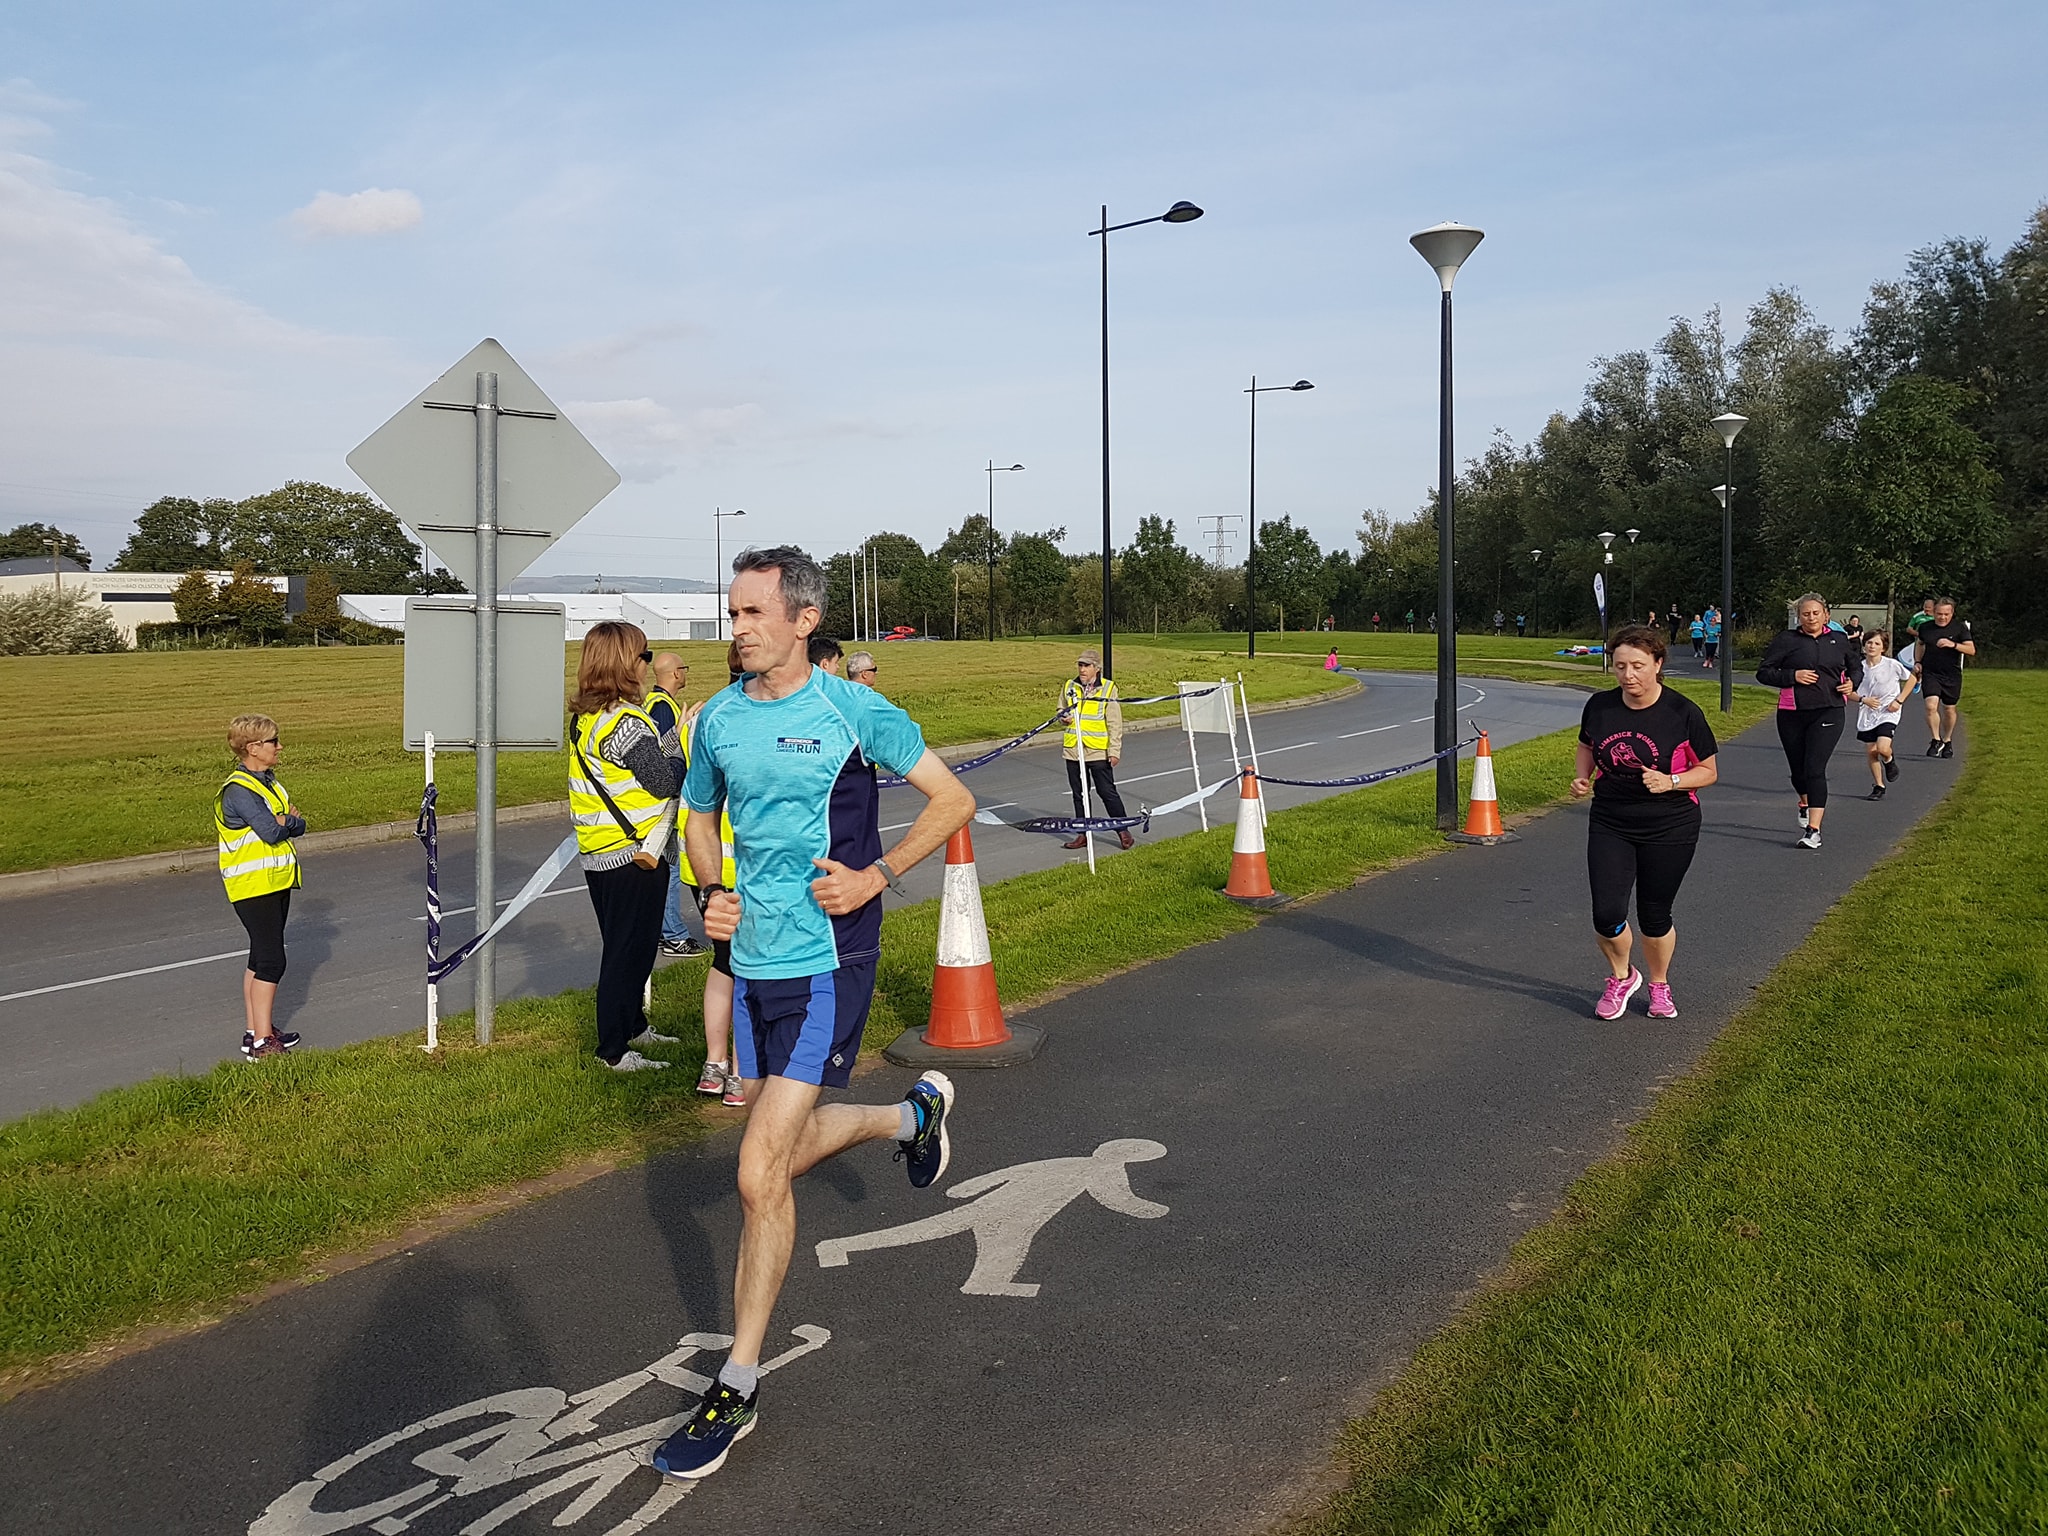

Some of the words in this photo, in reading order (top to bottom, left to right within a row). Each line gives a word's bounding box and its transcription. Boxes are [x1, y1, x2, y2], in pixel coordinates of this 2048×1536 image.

[797, 744, 820, 754] RUN
[1599, 731, 1632, 749] LIMERICK
[1636, 732, 1659, 757] WOMENS
